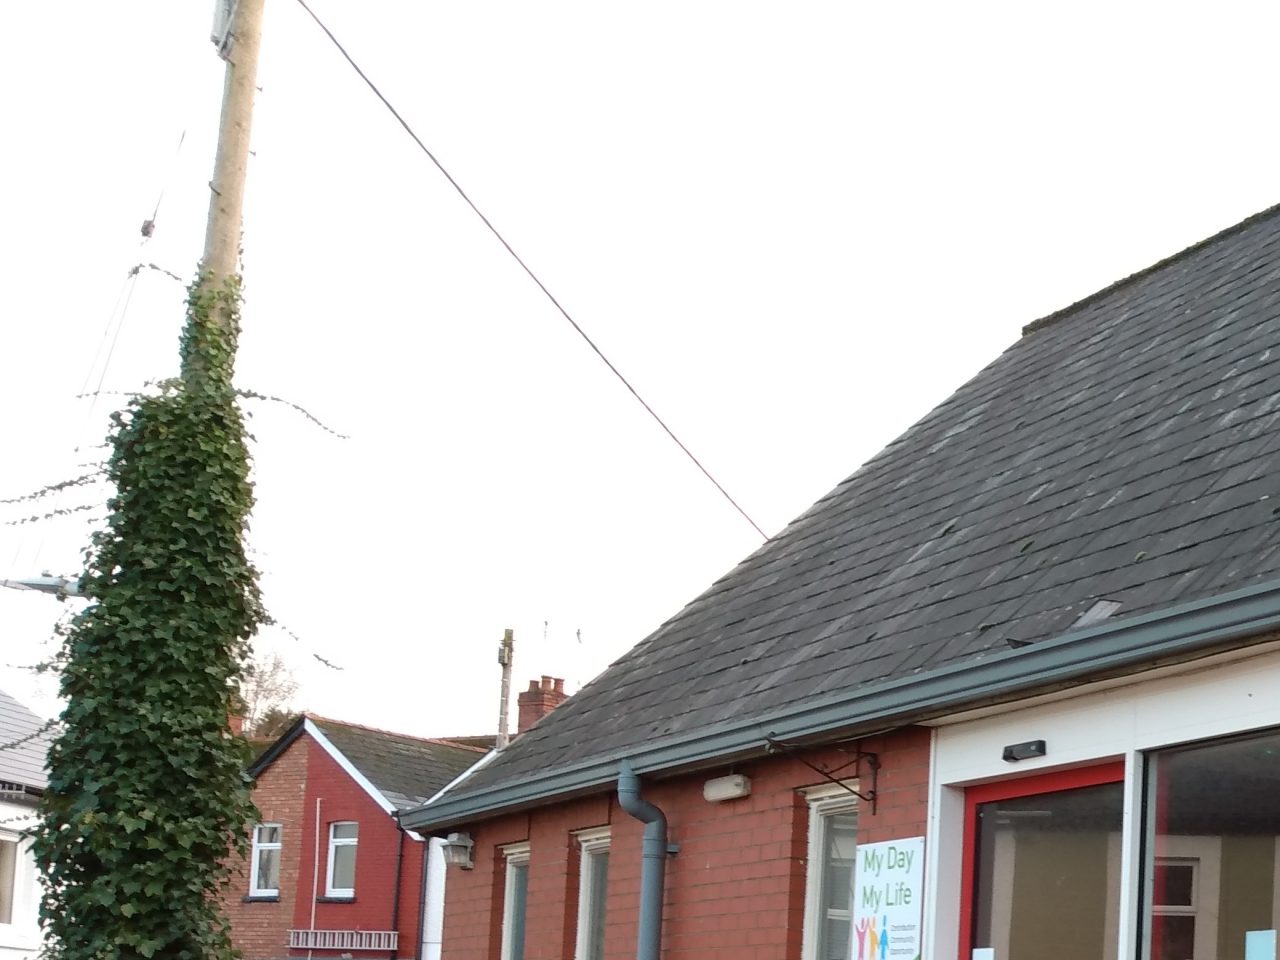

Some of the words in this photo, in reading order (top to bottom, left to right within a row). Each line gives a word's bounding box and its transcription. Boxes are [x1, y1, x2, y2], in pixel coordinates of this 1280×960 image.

[864, 848, 884, 877] My
[887, 846, 915, 874] Day
[862, 885, 882, 914] My
[886, 882, 912, 906] Life
